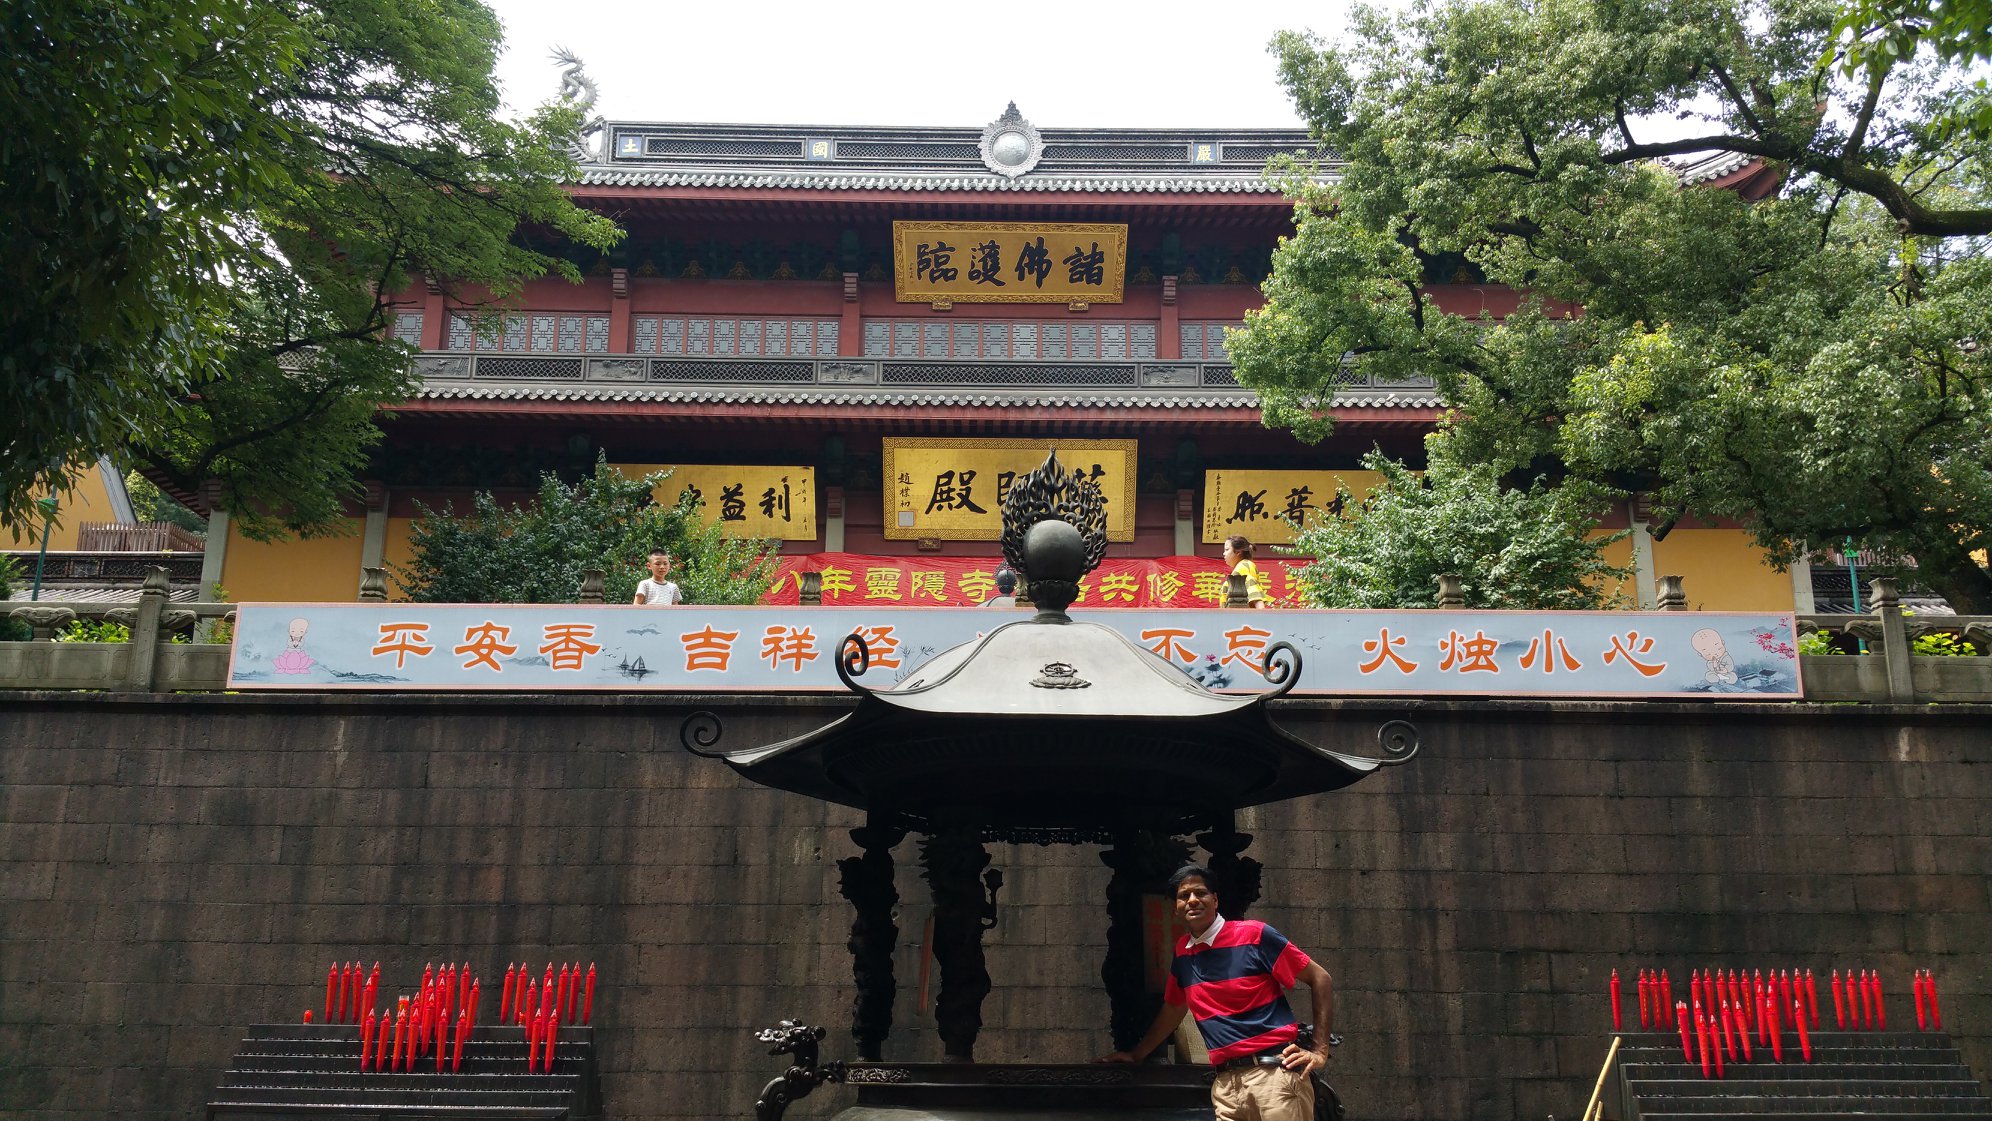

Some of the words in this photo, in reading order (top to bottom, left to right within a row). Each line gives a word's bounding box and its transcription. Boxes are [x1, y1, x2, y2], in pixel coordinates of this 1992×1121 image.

[372, 621, 601, 672] 平安香
[681, 624, 900, 672] 吉祥经
[1360, 627, 1666, 677] 火烛小心
